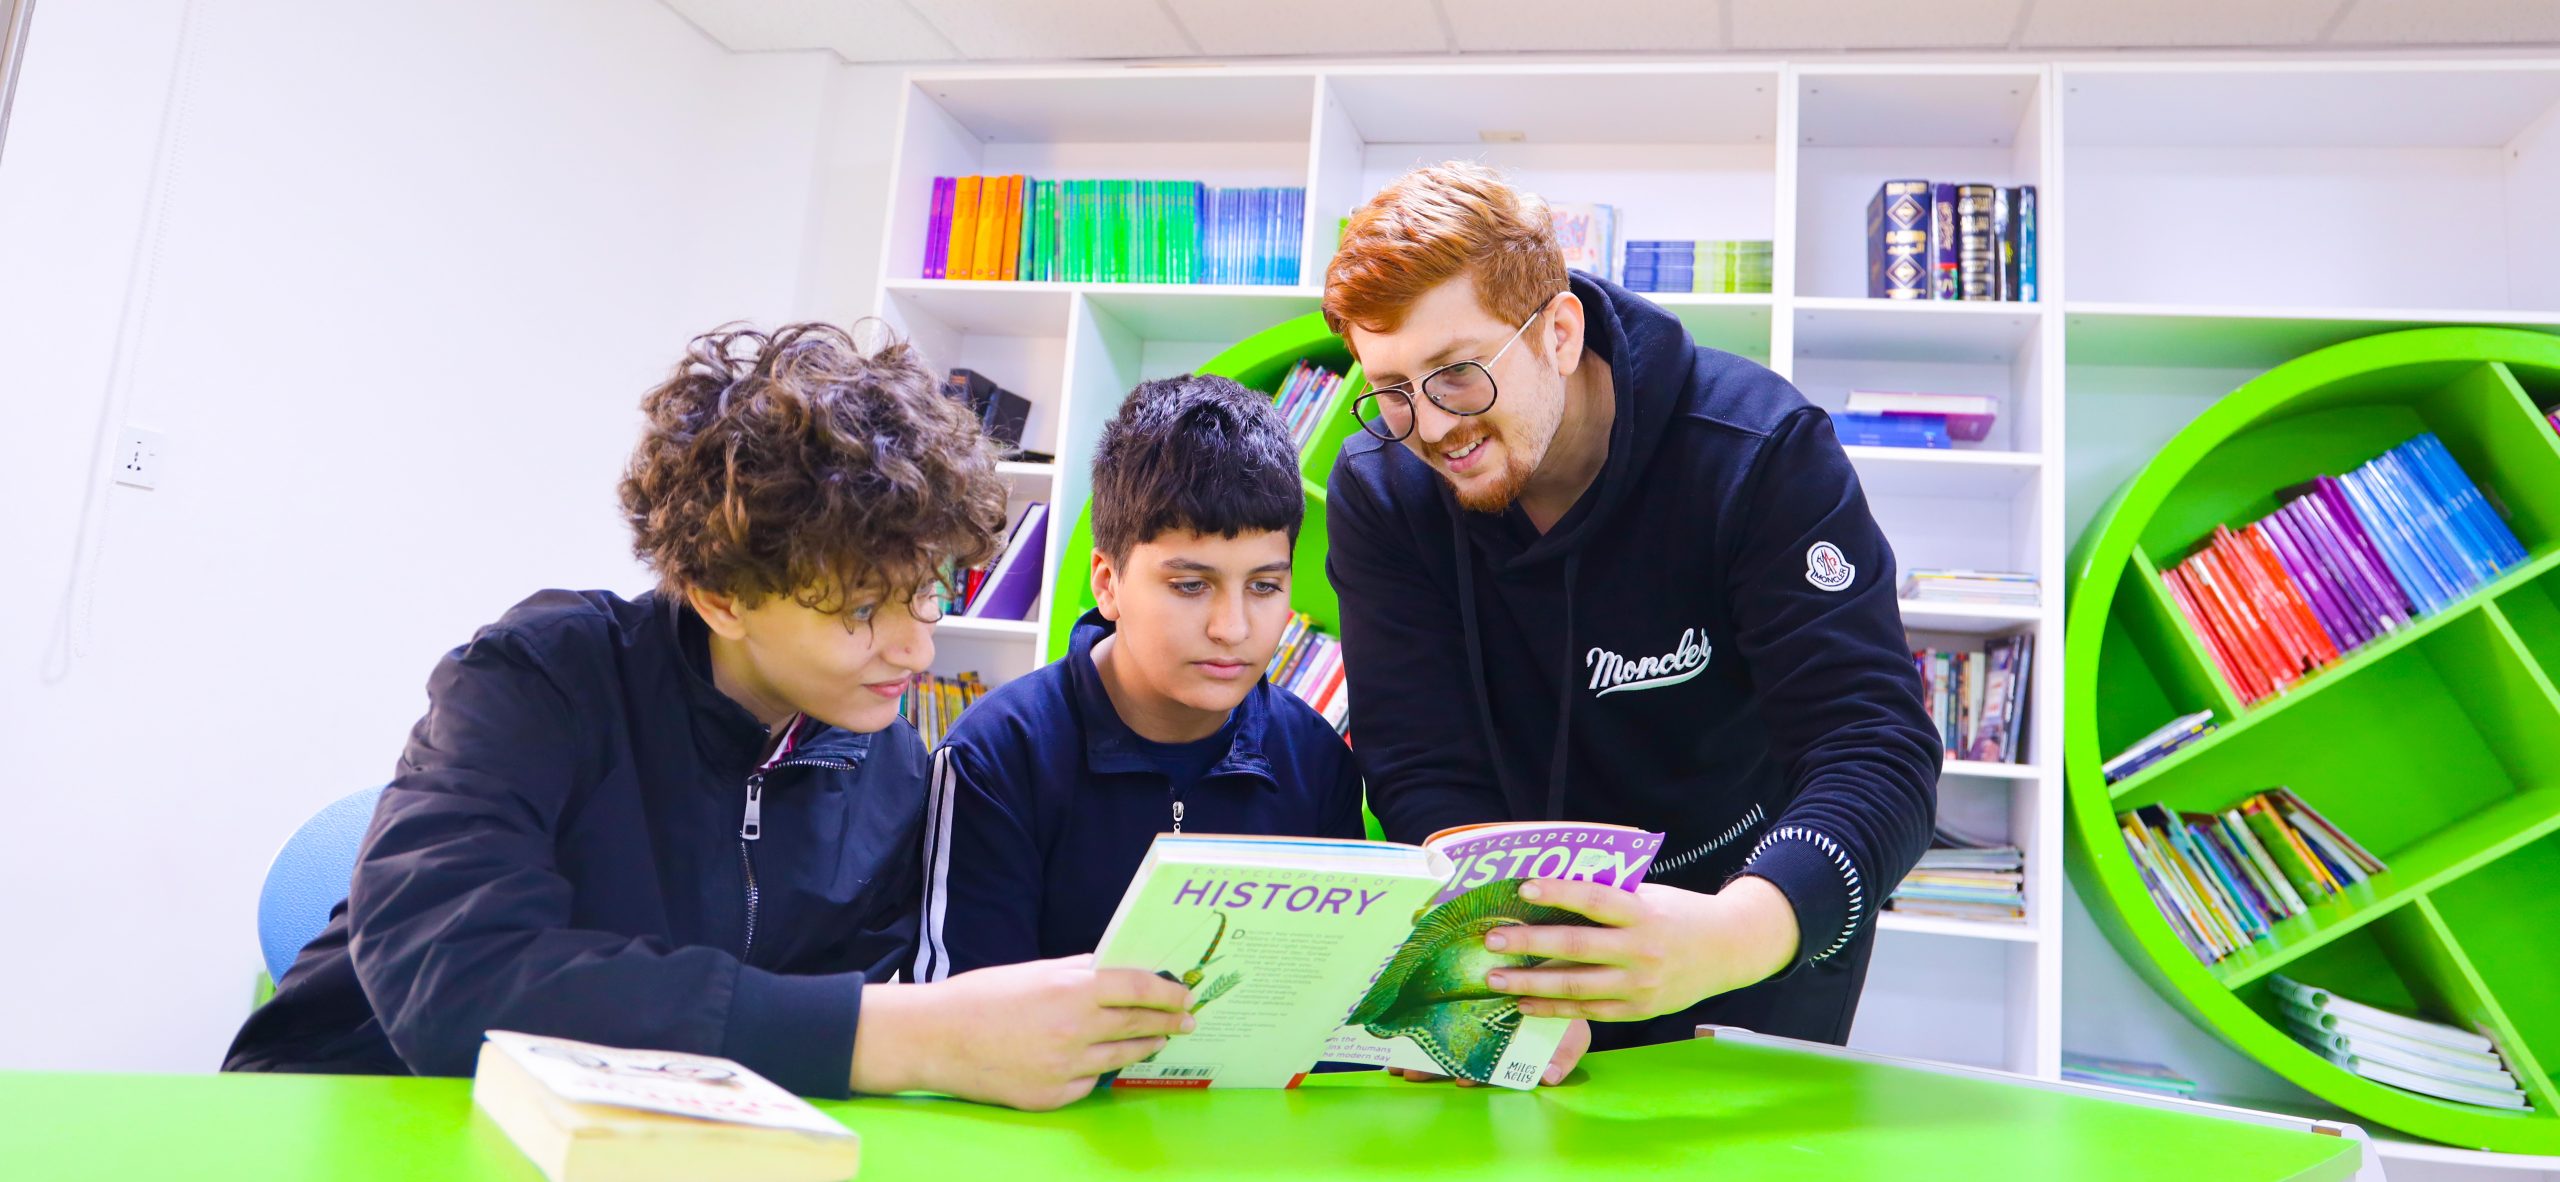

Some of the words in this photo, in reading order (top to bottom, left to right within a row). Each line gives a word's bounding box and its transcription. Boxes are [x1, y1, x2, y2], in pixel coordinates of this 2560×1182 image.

[1814, 568, 1846, 583] MONCLER
[1446, 832, 1614, 856] NCYCLOPEDIA
[1632, 838, 1661, 850] OF
[1446, 846, 1652, 892] ISTORY
[1172, 879, 1388, 916] HISTORY
